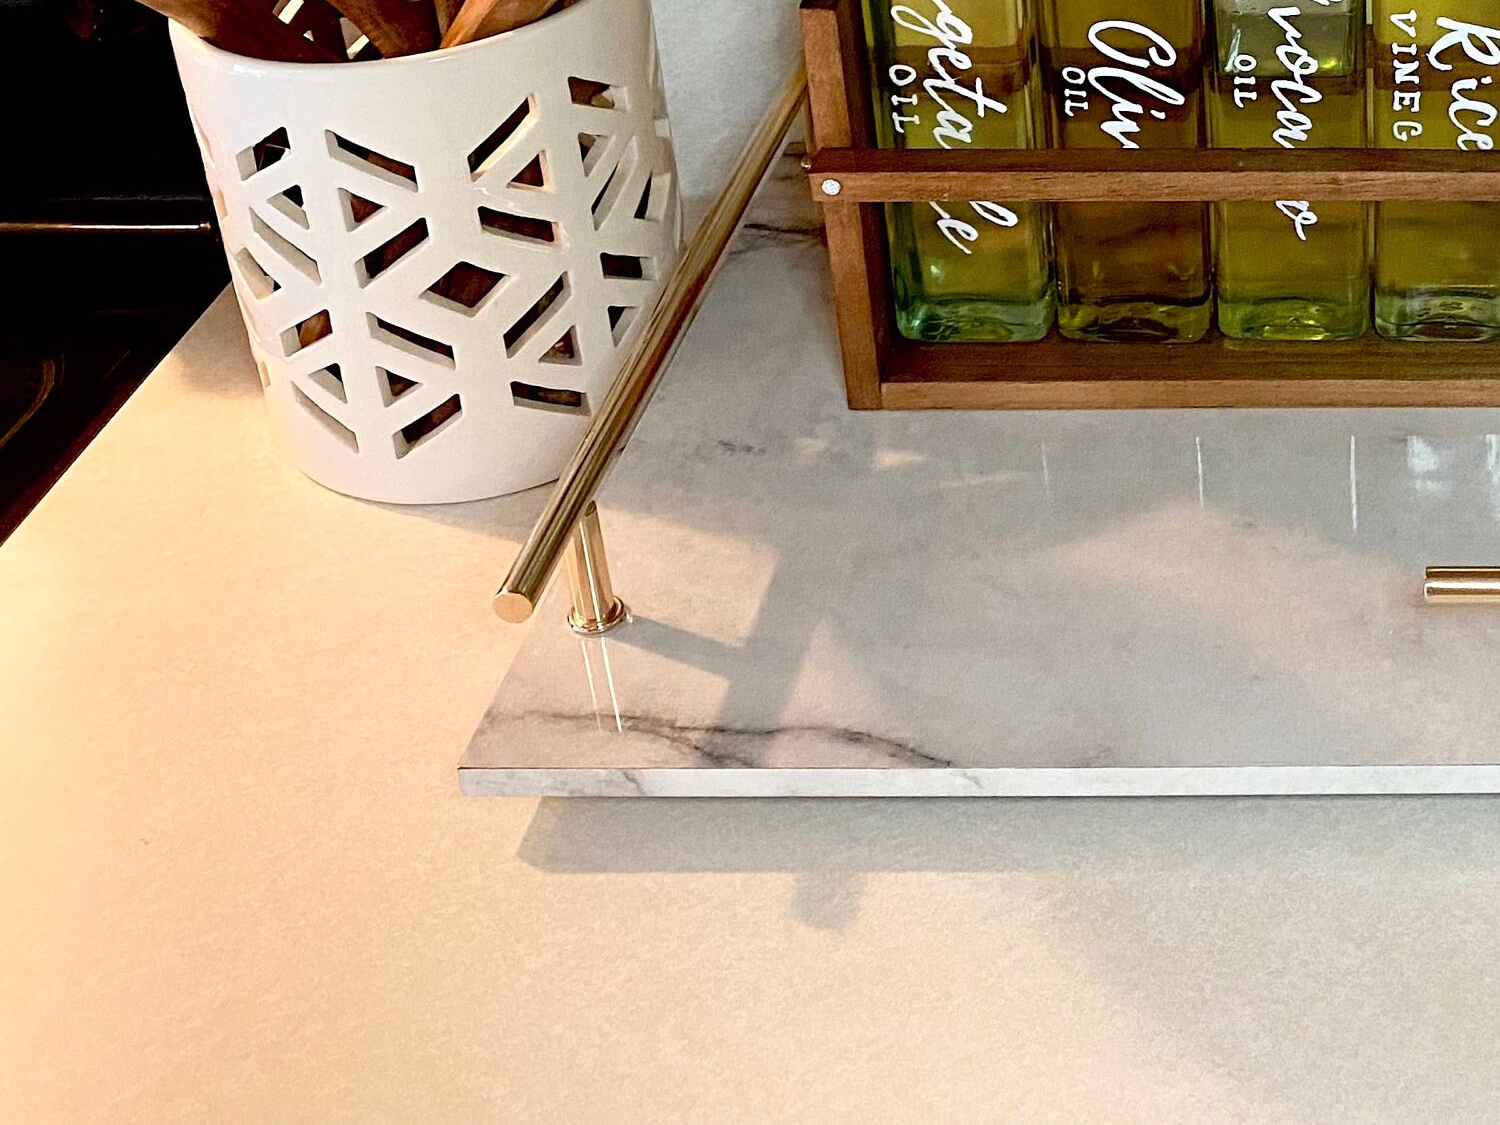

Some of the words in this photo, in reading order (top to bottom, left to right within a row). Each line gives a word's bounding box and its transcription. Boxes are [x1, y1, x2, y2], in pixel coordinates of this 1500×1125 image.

[889, 64, 920, 134] OIL
[1062, 66, 1089, 117] OIL
[1087, 20, 1186, 149] Oliv
[1233, 53, 1258, 109] OIL
[1389, 9, 1423, 142] VINEG
